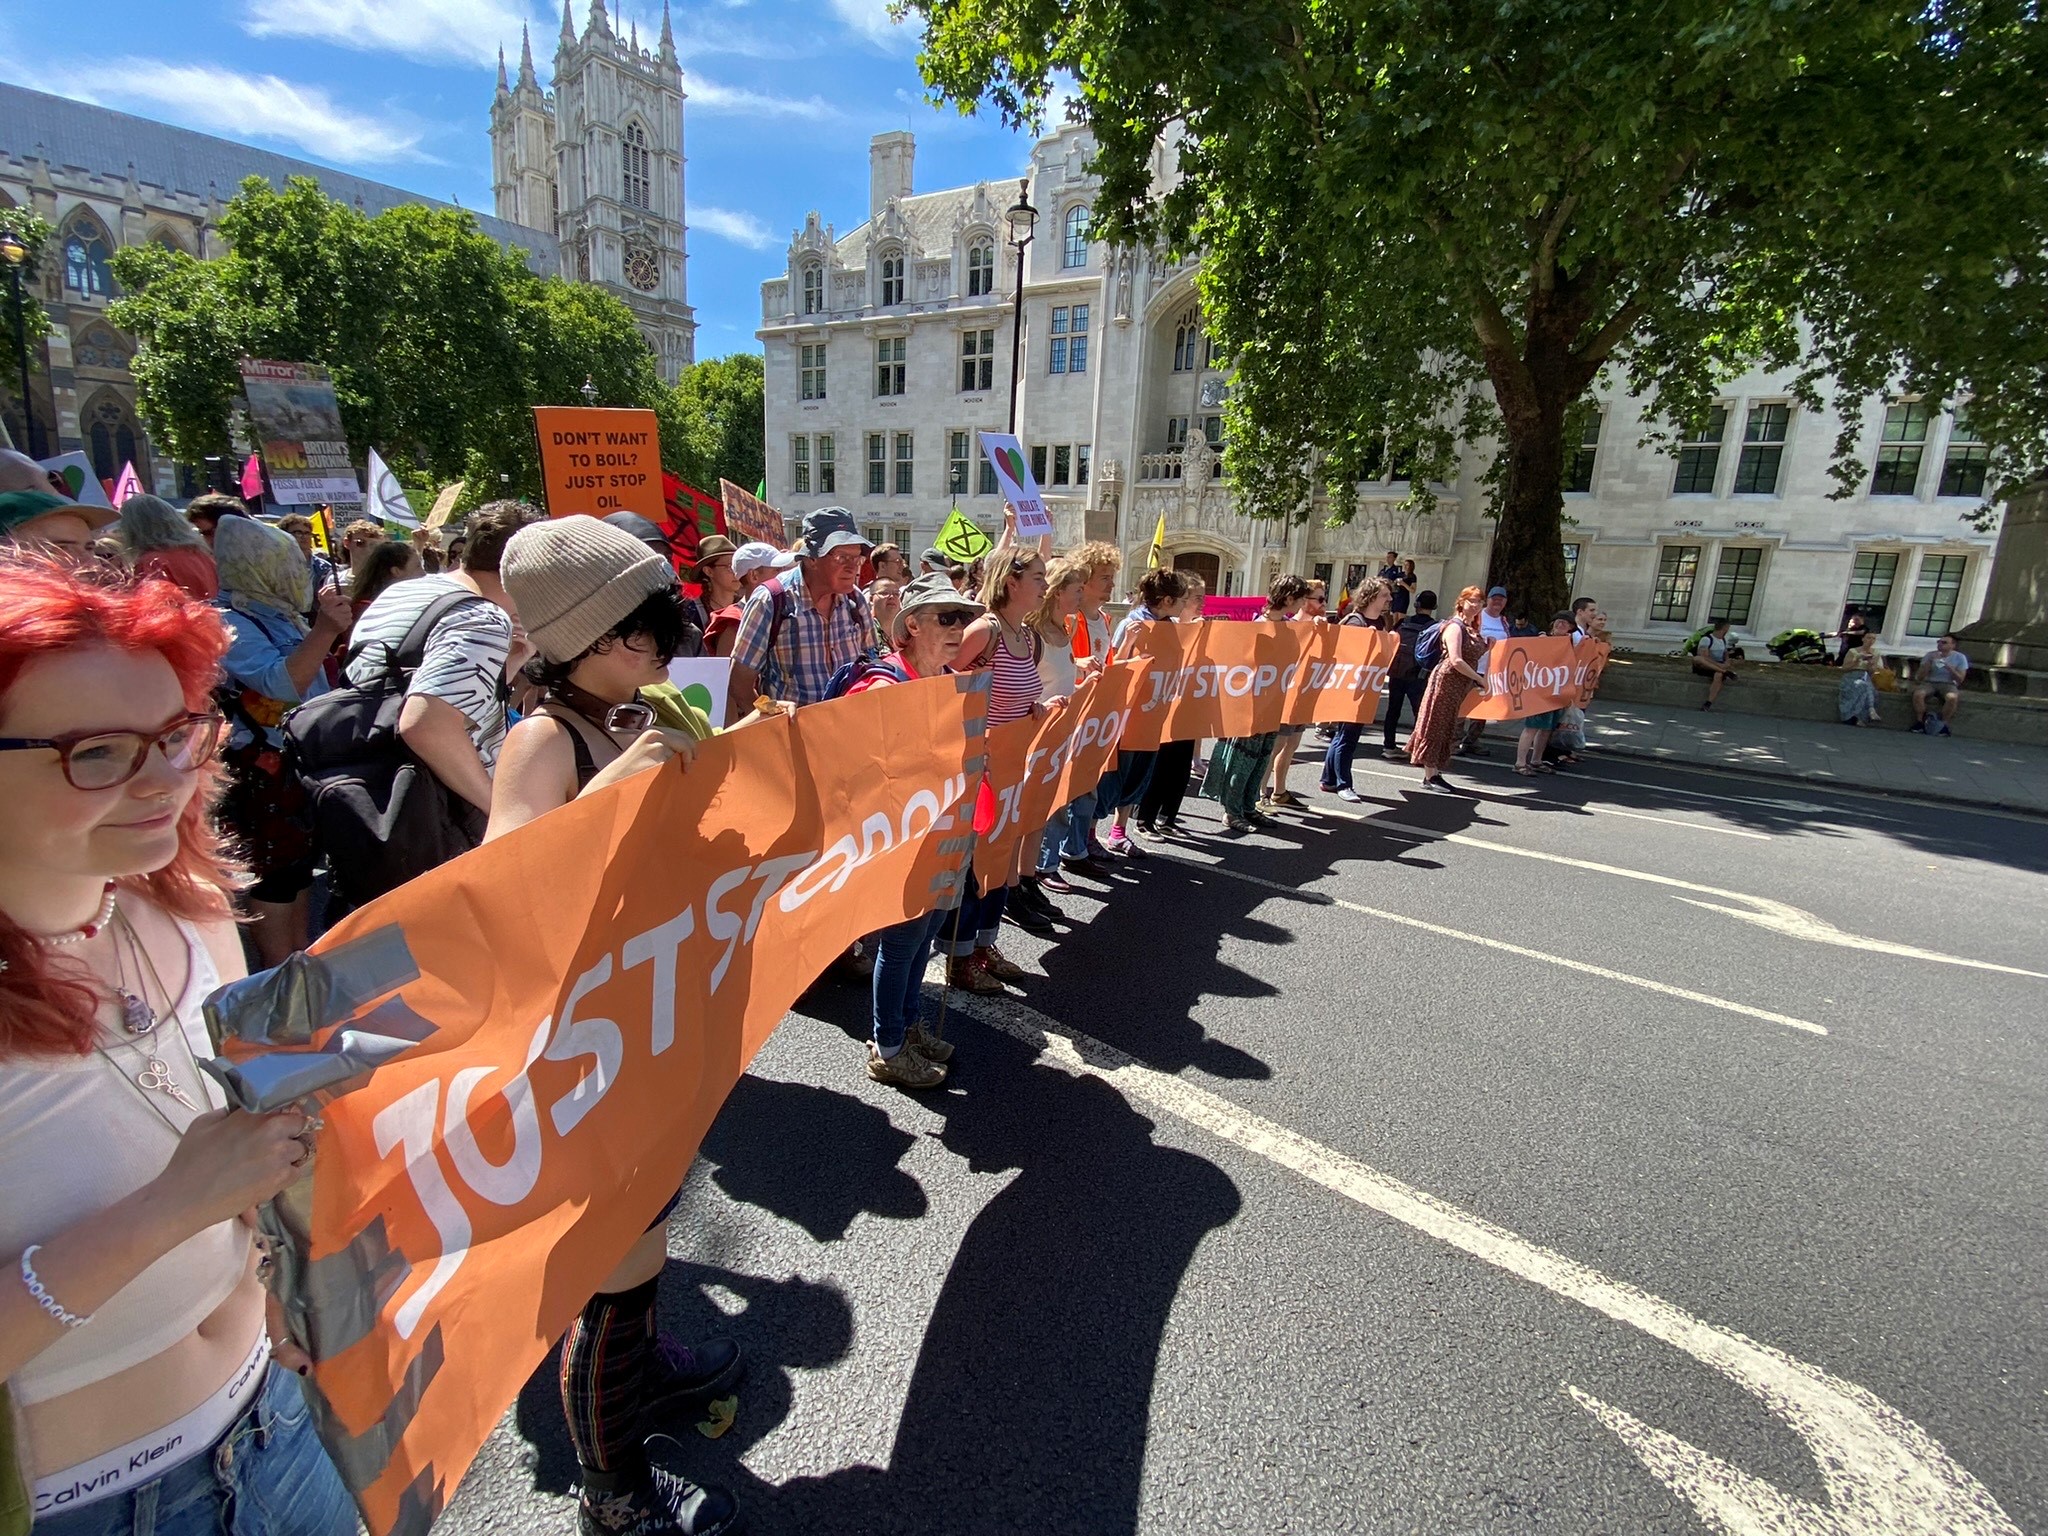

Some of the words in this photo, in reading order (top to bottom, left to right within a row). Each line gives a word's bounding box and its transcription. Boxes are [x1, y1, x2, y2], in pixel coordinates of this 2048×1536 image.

[243, 360, 293, 377] Mirror
[552, 432, 601, 446] DON'T
[605, 432, 648, 445] WANT
[303, 441, 349, 454] BRITAIN'S
[306, 454, 352, 468] BURNING
[569, 454, 591, 467] TO
[596, 453, 638, 467] BOIL?
[272, 479, 300, 490] FOSSIL
[301, 479, 323, 489] FUELS
[565, 475, 605, 489] JUST
[610, 474, 647, 487] STOP
[597, 495, 622, 508] OIL
[1193, 664, 1278, 698] STOP
[1301, 662, 1355, 694] JUST
[1346, 665, 1389, 693] STO
[1523, 660, 1570, 696] Stop
[373, 903, 695, 1339] JUST
[229, 1346, 265, 1400] Calvin
[35, 1467, 120, 1512] Calvin
[129, 1434, 183, 1473] Klein
